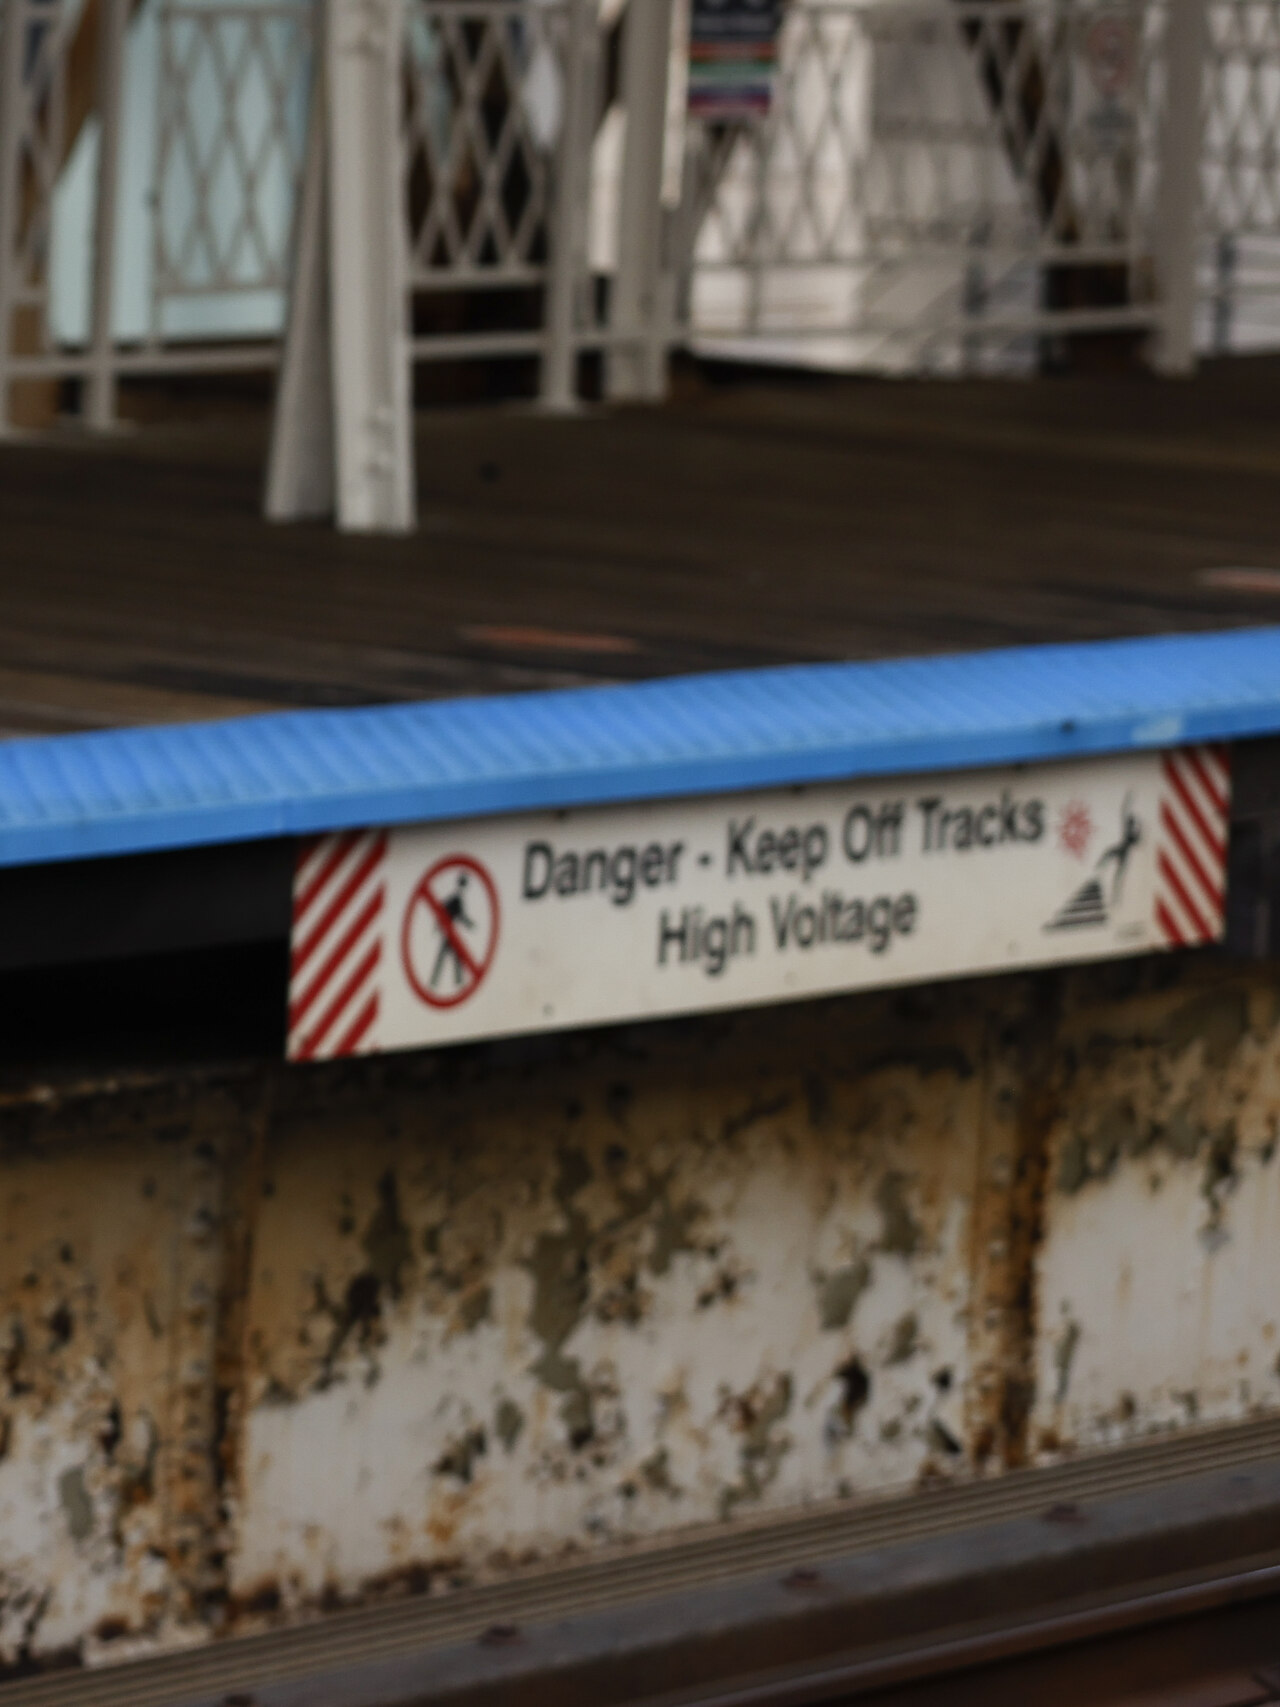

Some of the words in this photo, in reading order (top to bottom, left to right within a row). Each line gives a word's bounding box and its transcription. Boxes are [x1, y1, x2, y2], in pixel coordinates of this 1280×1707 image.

[522, 838, 685, 907] Danger
[725, 815, 828, 882] Keep
[842, 800, 906, 863] Off
[917, 790, 1045, 852] Tracks
[657, 901, 756, 976] High
[768, 889, 917, 954] Voltage
